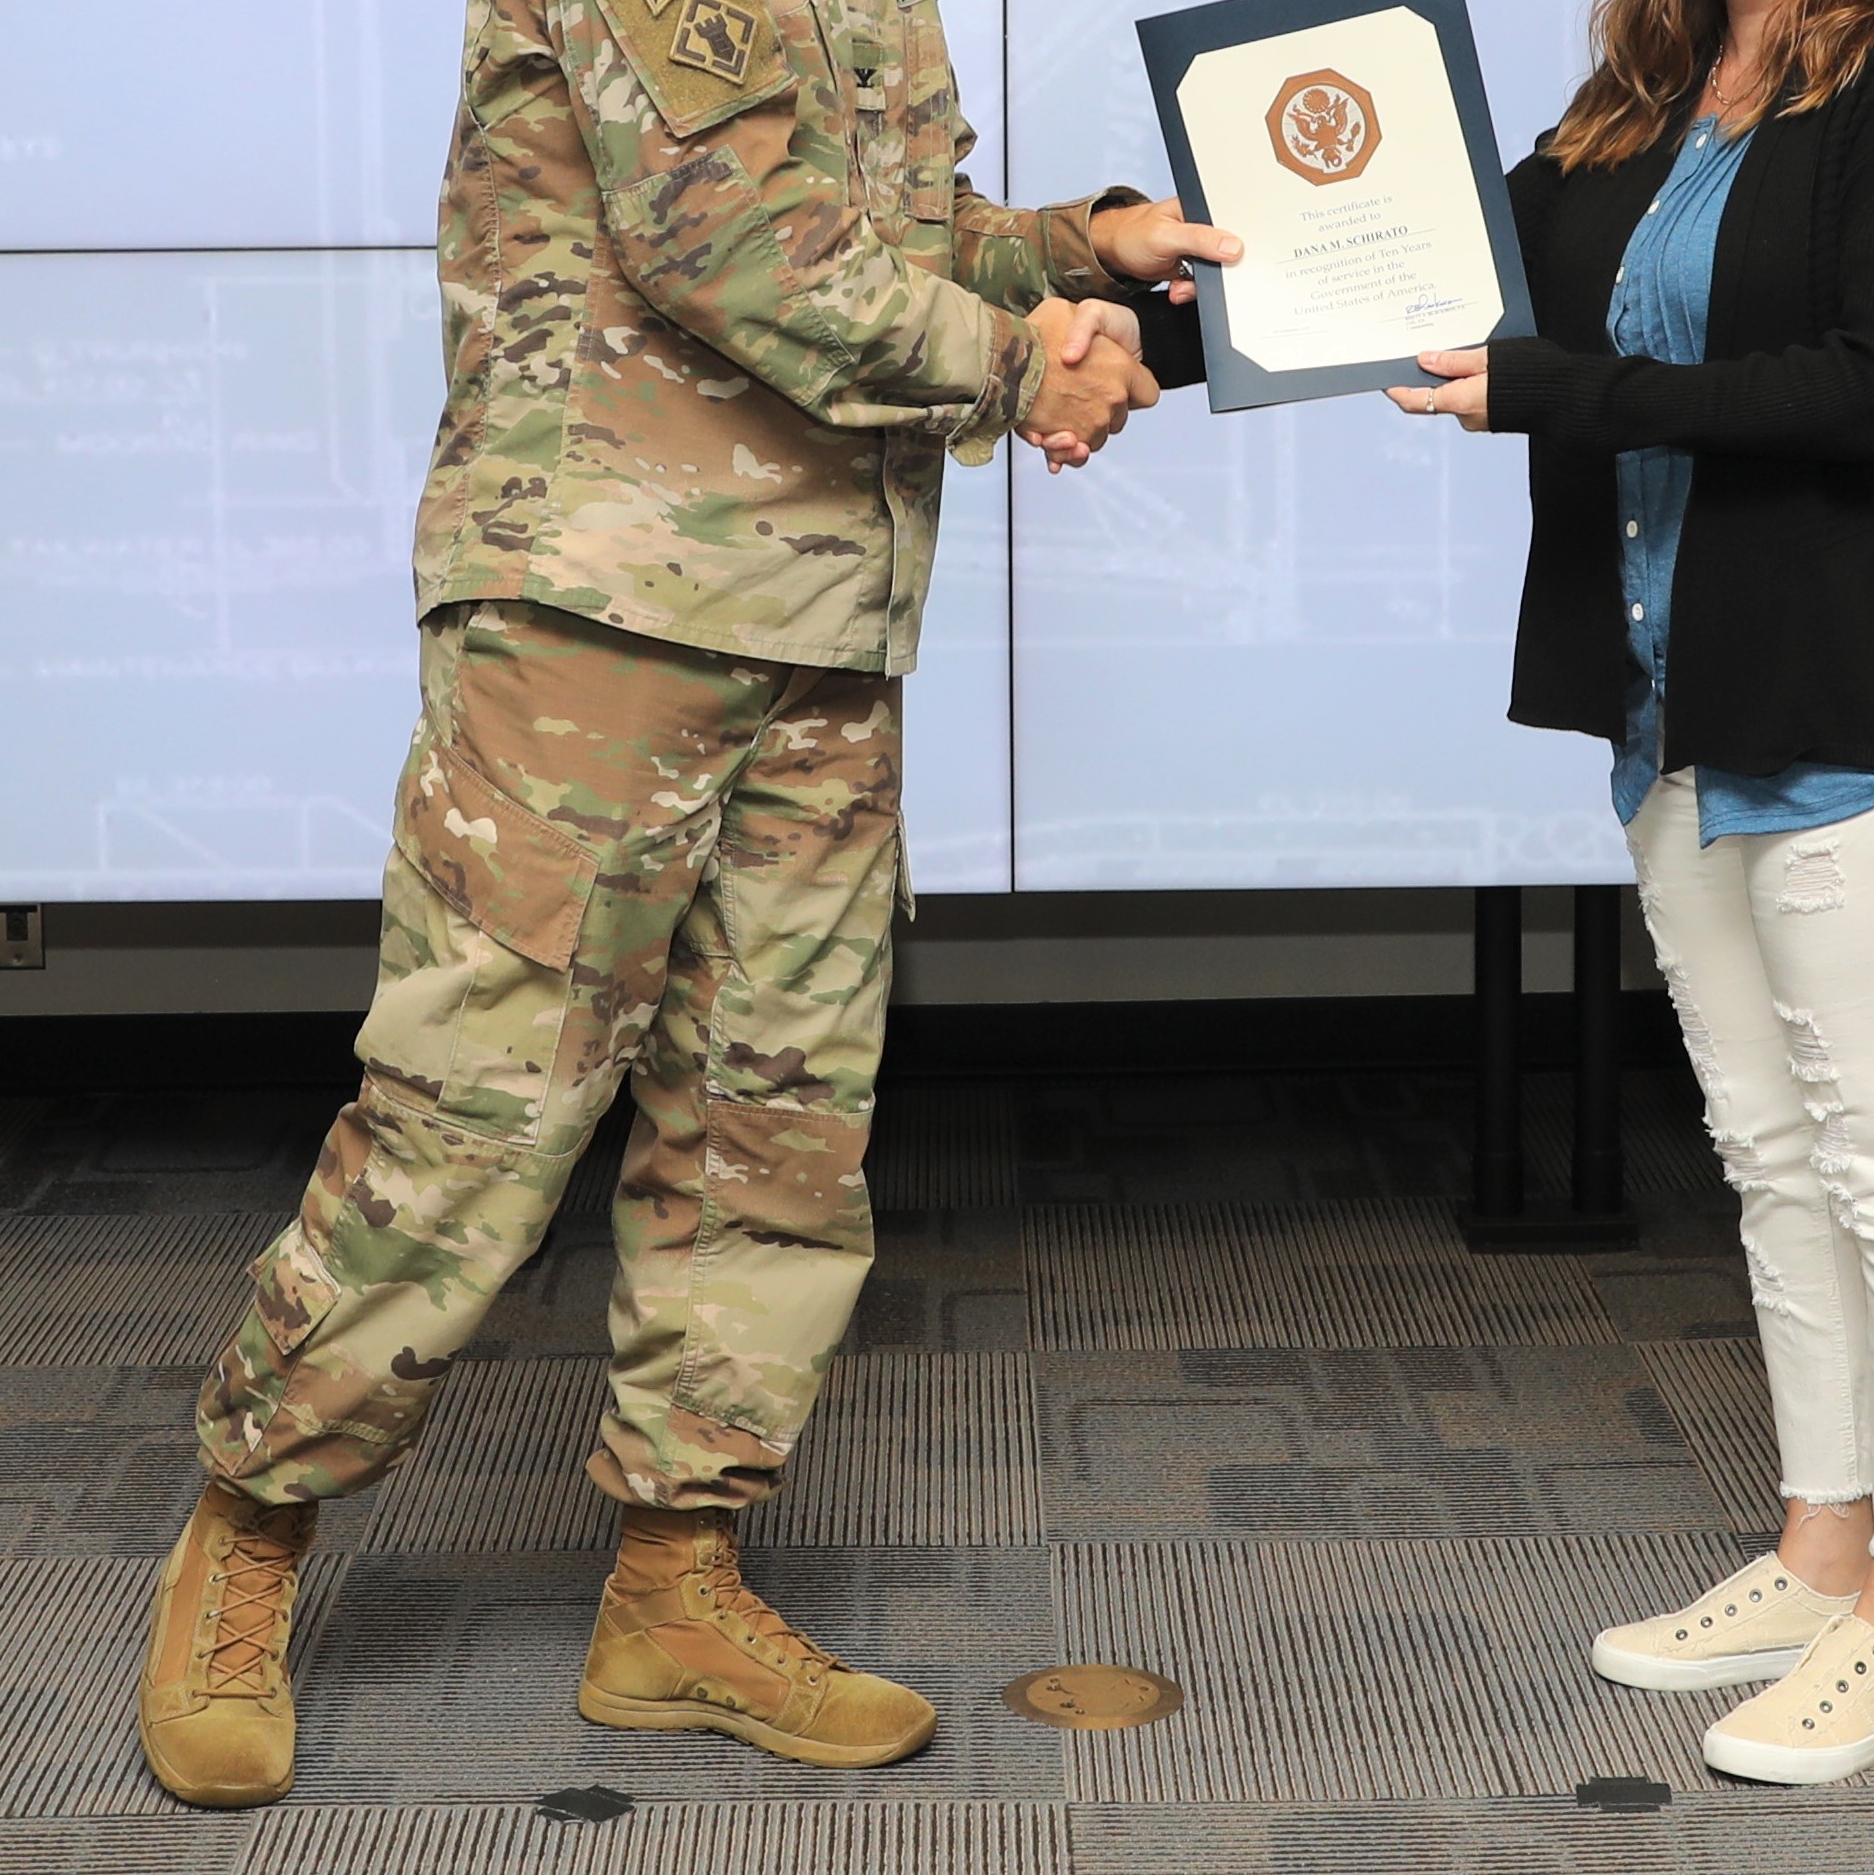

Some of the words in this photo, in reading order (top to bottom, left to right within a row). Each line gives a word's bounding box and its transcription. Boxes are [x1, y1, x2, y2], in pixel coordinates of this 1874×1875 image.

[1300, 210, 1325, 223] This
[1327, 199, 1381, 216] certificate
[1383, 195, 1393, 205] is
[1318, 214, 1367, 232] awarded
[1370, 212, 1381, 221] to
[1293, 243, 1328, 259] DANA
[1330, 239, 1344, 252] M.
[1347, 225, 1408, 246] SCHIRATO
[1285, 269, 1297, 279] in
[1299, 255, 1363, 277] recognition
[1365, 250, 1378, 263] of
[1379, 247, 1400, 260] Ten
[1402, 240, 1432, 254] Years
[1317, 274, 1330, 287] of
[1332, 268, 1371, 283] service
[1372, 263, 1385, 274] in
[1387, 259, 1405, 270] the
[1293, 300, 1335, 316] United
[1336, 294, 1370, 309] States
[1372, 290, 1387, 303] of
[1387, 282, 1437, 299] America.
[1310, 280, 1382, 301] Government
[1384, 274, 1398, 286] of
[1399, 270, 1417, 282] the
